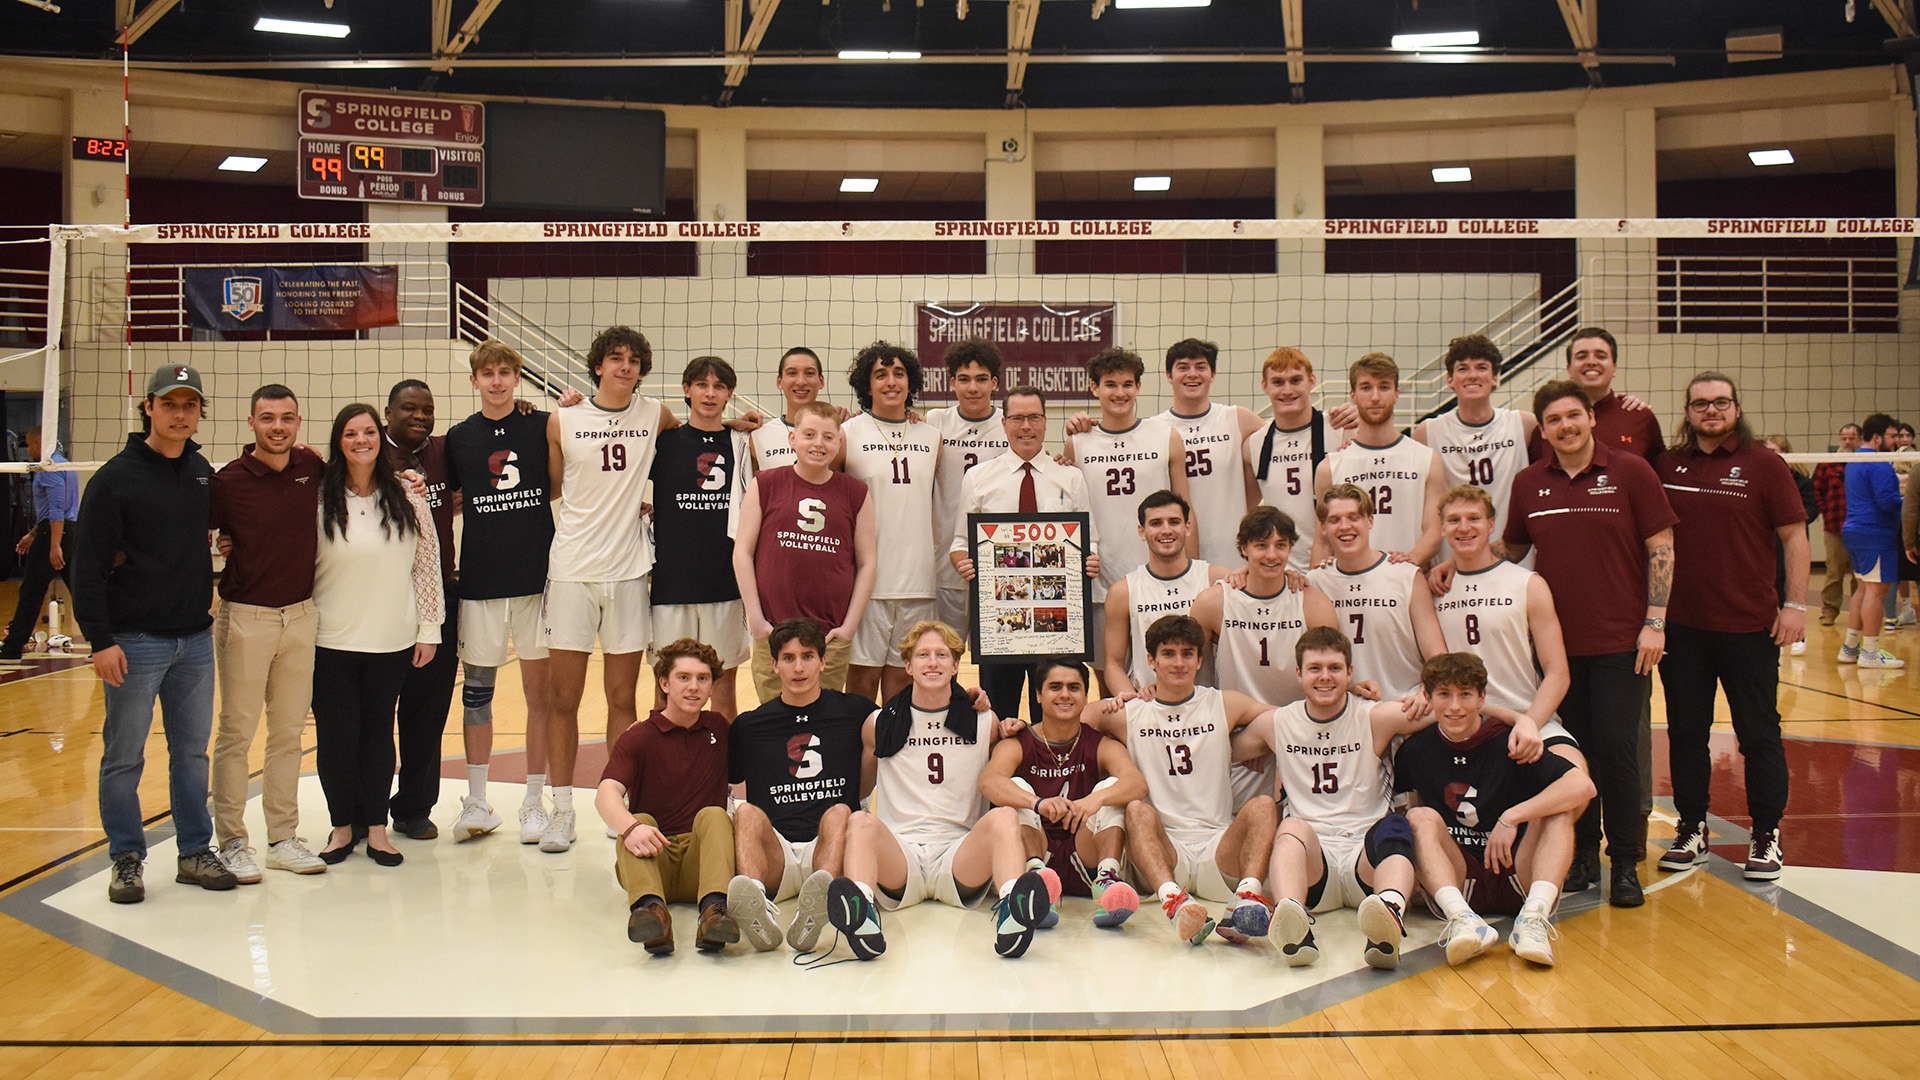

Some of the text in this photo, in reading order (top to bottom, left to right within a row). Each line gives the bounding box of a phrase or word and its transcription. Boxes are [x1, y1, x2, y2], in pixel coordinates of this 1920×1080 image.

[336, 102, 452, 121] SPRINGFIELD
[354, 118, 435, 135] COLLEGE
[455, 132, 480, 143] Enjoy
[87, 139, 125, 157] 8:22
[308, 142, 341, 155] HOME
[355, 145, 385, 170] 99
[439, 149, 482, 163] VISITOR
[311, 157, 343, 182] 99
[319, 185, 348, 195] BONUS
[370, 181, 400, 192] PERIOD
[437, 191, 465, 201] BONUS
[157, 223, 371, 239] SPRINGFIELD COLLEGE
[543, 222, 761, 237] SPRINGFIELD COLLEGE
[935, 221, 1152, 236] SPRINGFIELD COLLEGE
[1325, 219, 1539, 234] SPRINGFIELD COLLEGE
[1707, 219, 1914, 234] SPRINGFIELD COLLEGE
[929, 316, 1101, 343] SPRINGFIELD COLLEGE
[1005, 366, 1091, 392] OF BASKETBA
[575, 429, 649, 439] SPRINGFIELD
[1185, 434, 1230, 446] NGFIELD
[862, 444, 930, 453] SPRINGFIELD
[943, 438, 1009, 448] PRINGFIELD
[1441, 440, 1515, 454] SPRINGFIELD
[601, 444, 627, 471] 19
[1084, 452, 1159, 464] SPRINGFIELD
[1185, 448, 1212, 478] 25
[1272, 453, 1313, 463] RINGFI
[891, 457, 911, 484] 11
[1468, 457, 1494, 486] 10
[1106, 467, 1136, 496] 23
[1286, 467, 1301, 496] 5
[472, 488, 543, 505] SPRINGFIELD
[675, 493, 731, 501] SPRINGFIE
[1368, 485, 1392, 515] 12
[476, 498, 541, 514] VOLLEYBALL
[678, 502, 730, 510] VOLLEYBA
[777, 531, 841, 546] SPRINGFIELD
[1013, 523, 1057, 542] 500
[779, 540, 837, 553] VOLLEYBALL
[1137, 599, 1192, 613] SPRINGFI
[1334, 598, 1397, 608] RINGFIELD
[1438, 597, 1513, 612] SPRINGFIELD
[1225, 619, 1302, 631] SPRINGFIELD
[1349, 613, 1364, 644] 7
[1465, 614, 1481, 645] 8
[1259, 637, 1270, 667] 1
[908, 736, 977, 746] RINGFIEL
[1286, 742, 1361, 756] SPRINGFIELD
[1166, 744, 1194, 776] 13
[927, 752, 945, 785] 9
[1311, 762, 1339, 794] 15
[769, 777, 847, 795] SPRINGFIELD
[774, 788, 843, 805] VOLLEYBALL
